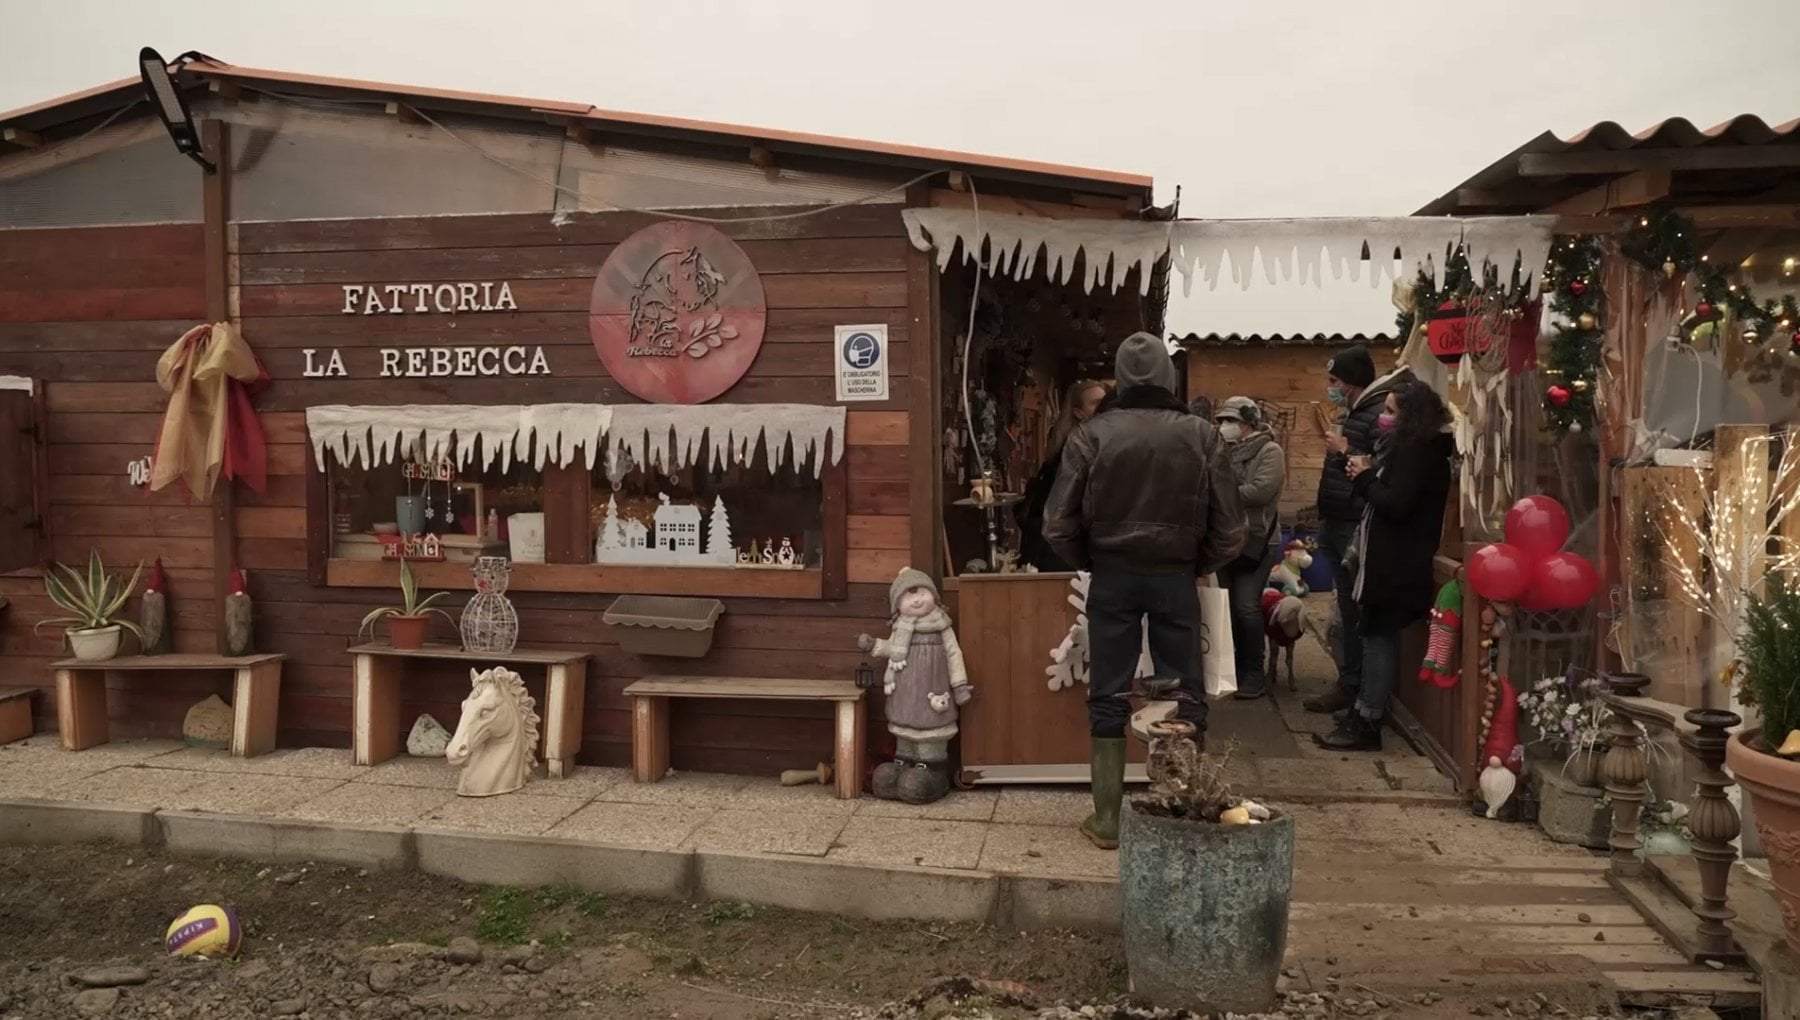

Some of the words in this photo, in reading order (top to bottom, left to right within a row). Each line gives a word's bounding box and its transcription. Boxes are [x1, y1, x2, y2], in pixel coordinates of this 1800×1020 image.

[342, 281, 517, 314] FATTORIA
[302, 348, 348, 377] LA
[380, 346, 551, 377] REBECCA
